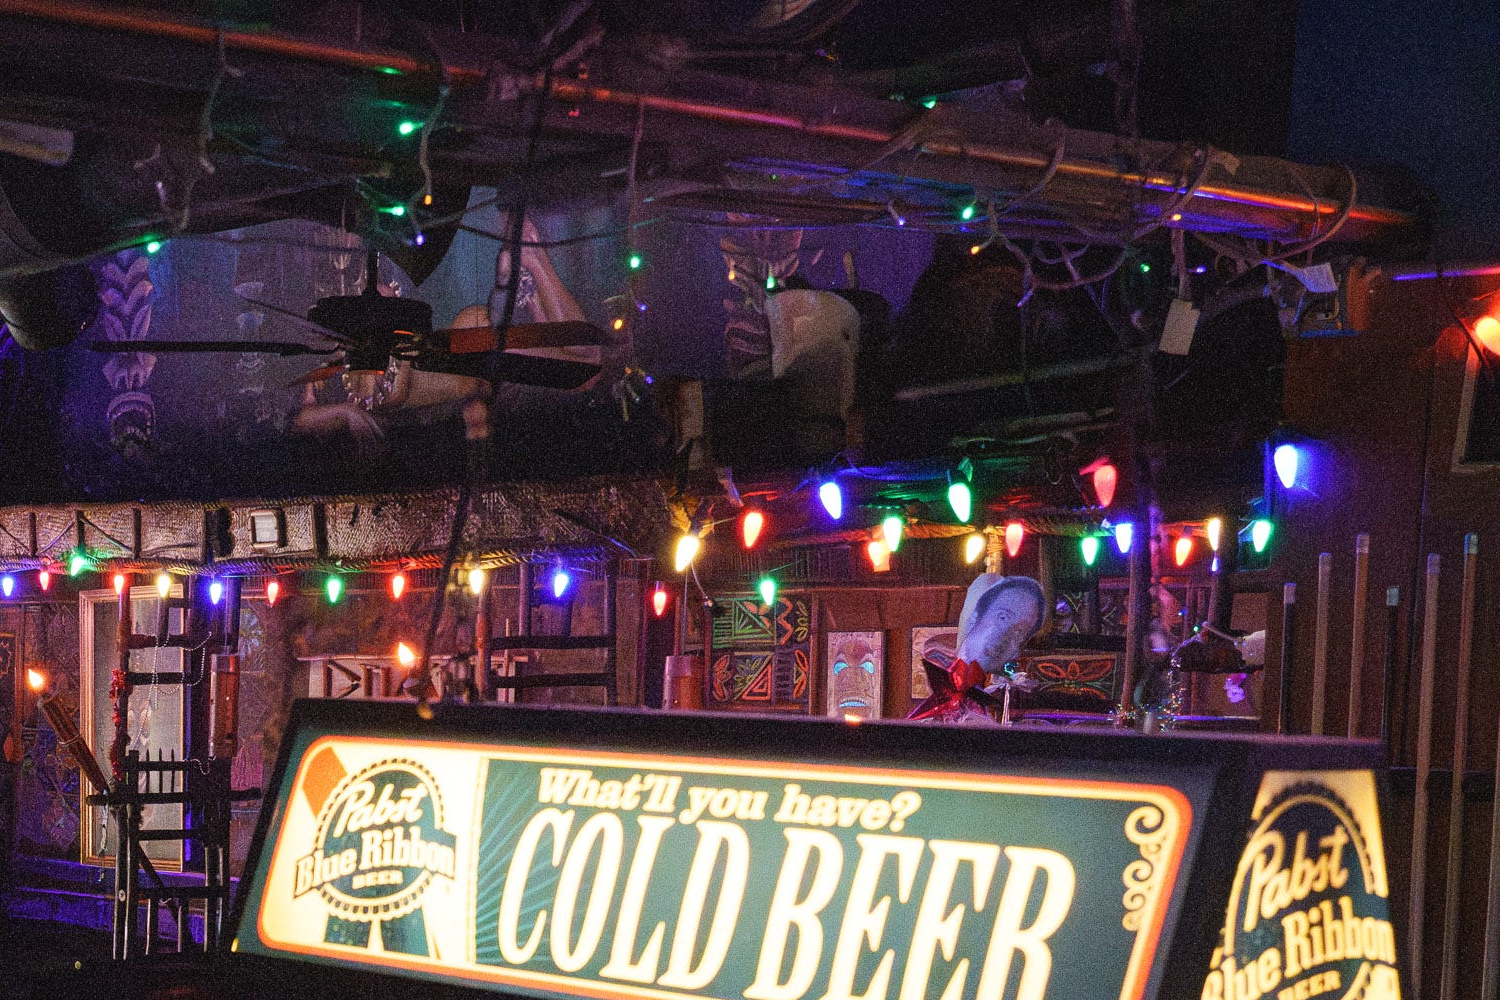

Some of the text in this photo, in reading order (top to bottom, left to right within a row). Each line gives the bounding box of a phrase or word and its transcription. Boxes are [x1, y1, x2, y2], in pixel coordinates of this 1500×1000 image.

[333, 780, 428, 838] Pabst
[539, 767, 923, 833] What'll you have?
[295, 825, 456, 899] Blue Ribbon
[352, 870, 403, 889] BEER
[498, 807, 750, 990] COLD
[1243, 825, 1350, 933] Pabst
[1281, 895, 1397, 978] Ribbon
